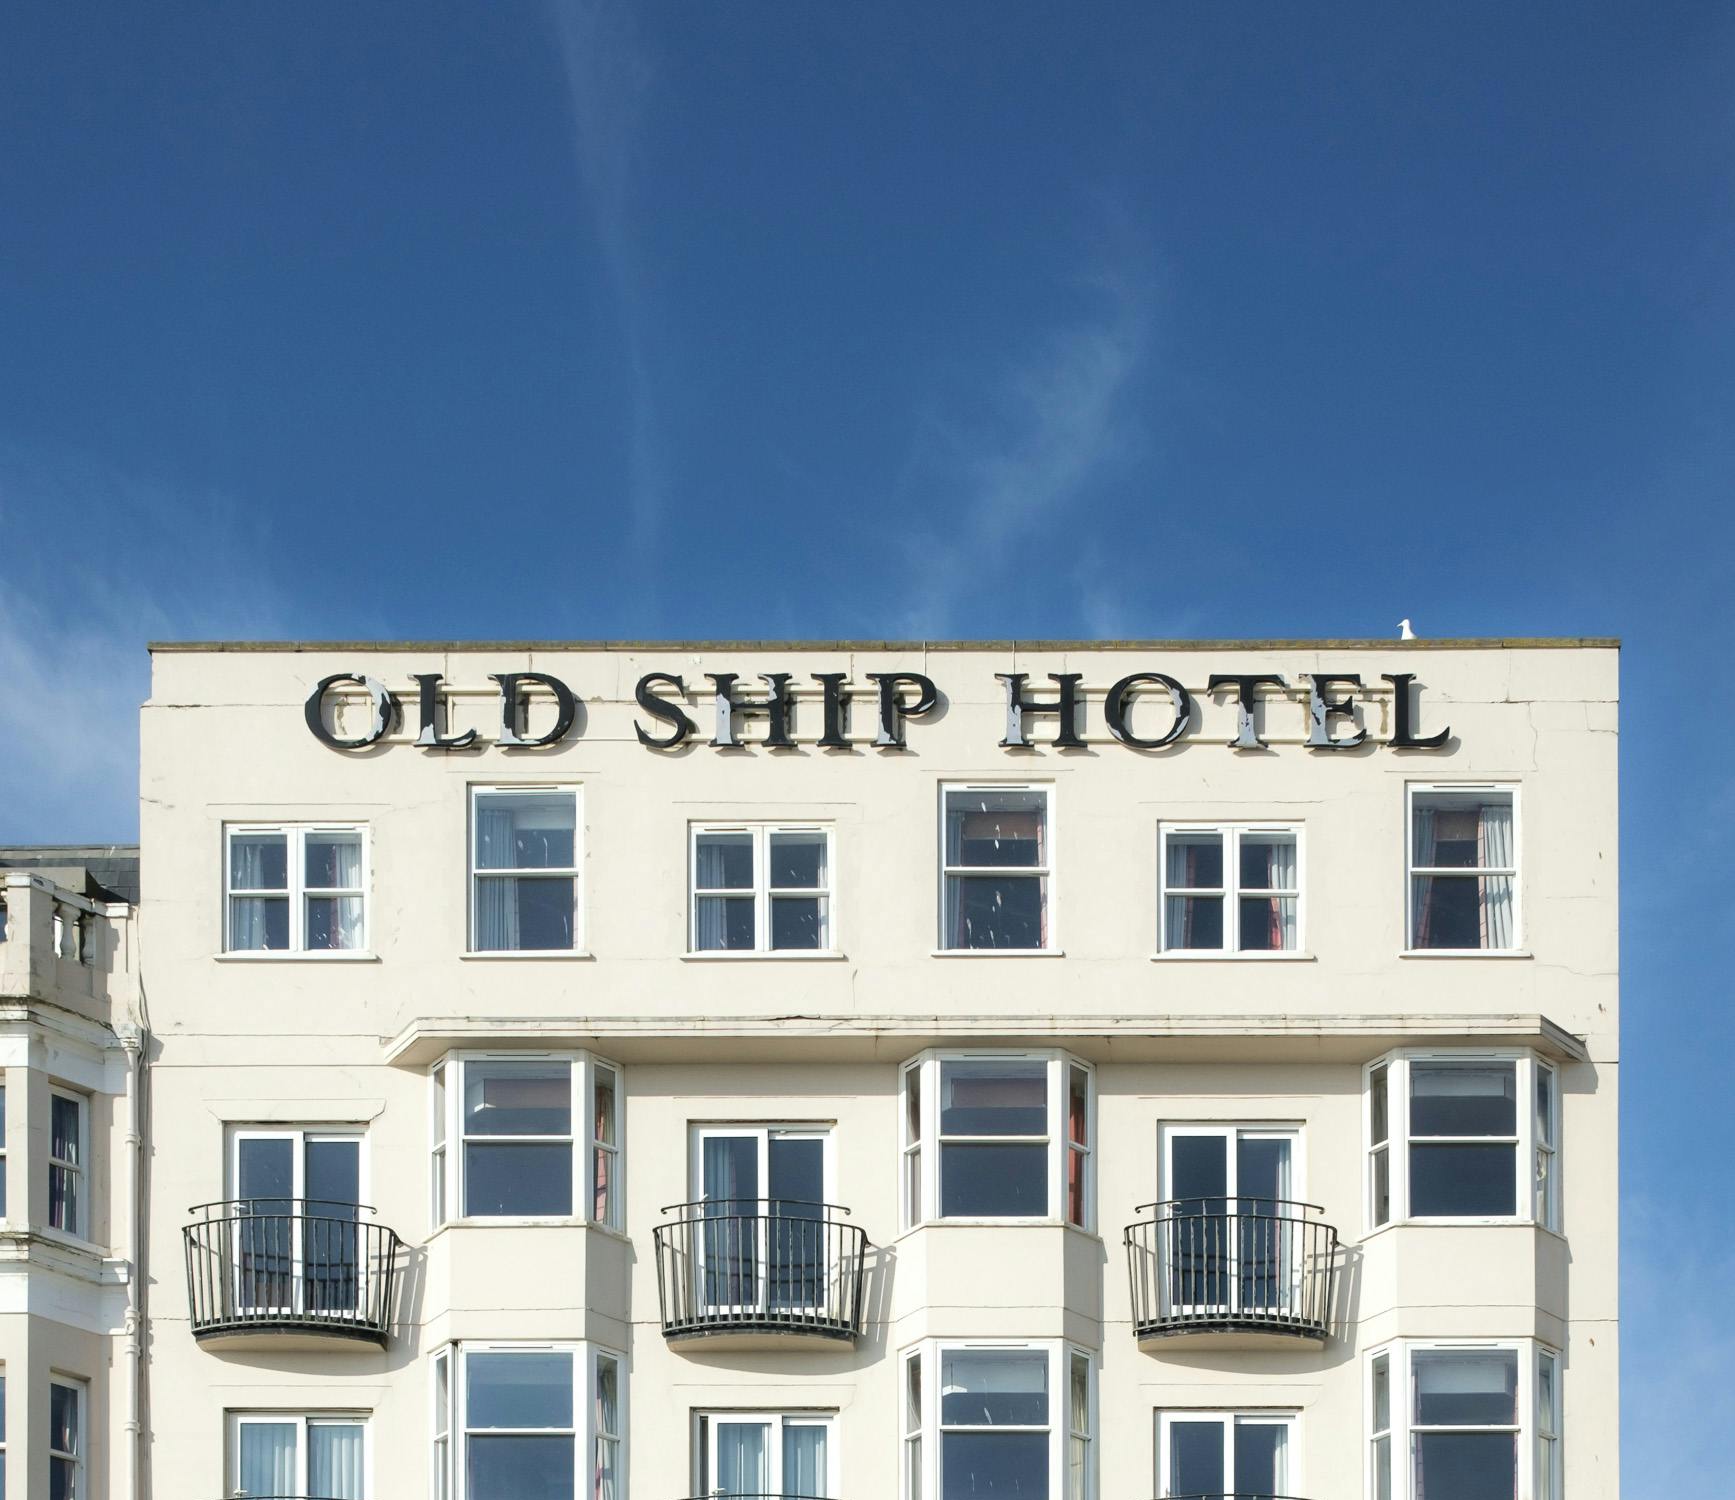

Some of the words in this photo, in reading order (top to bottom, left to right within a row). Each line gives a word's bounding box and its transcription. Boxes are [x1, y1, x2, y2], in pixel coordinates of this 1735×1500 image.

[304, 672, 576, 750] OLD
[632, 672, 938, 750] SHIP
[993, 672, 1452, 750] HOTEL
